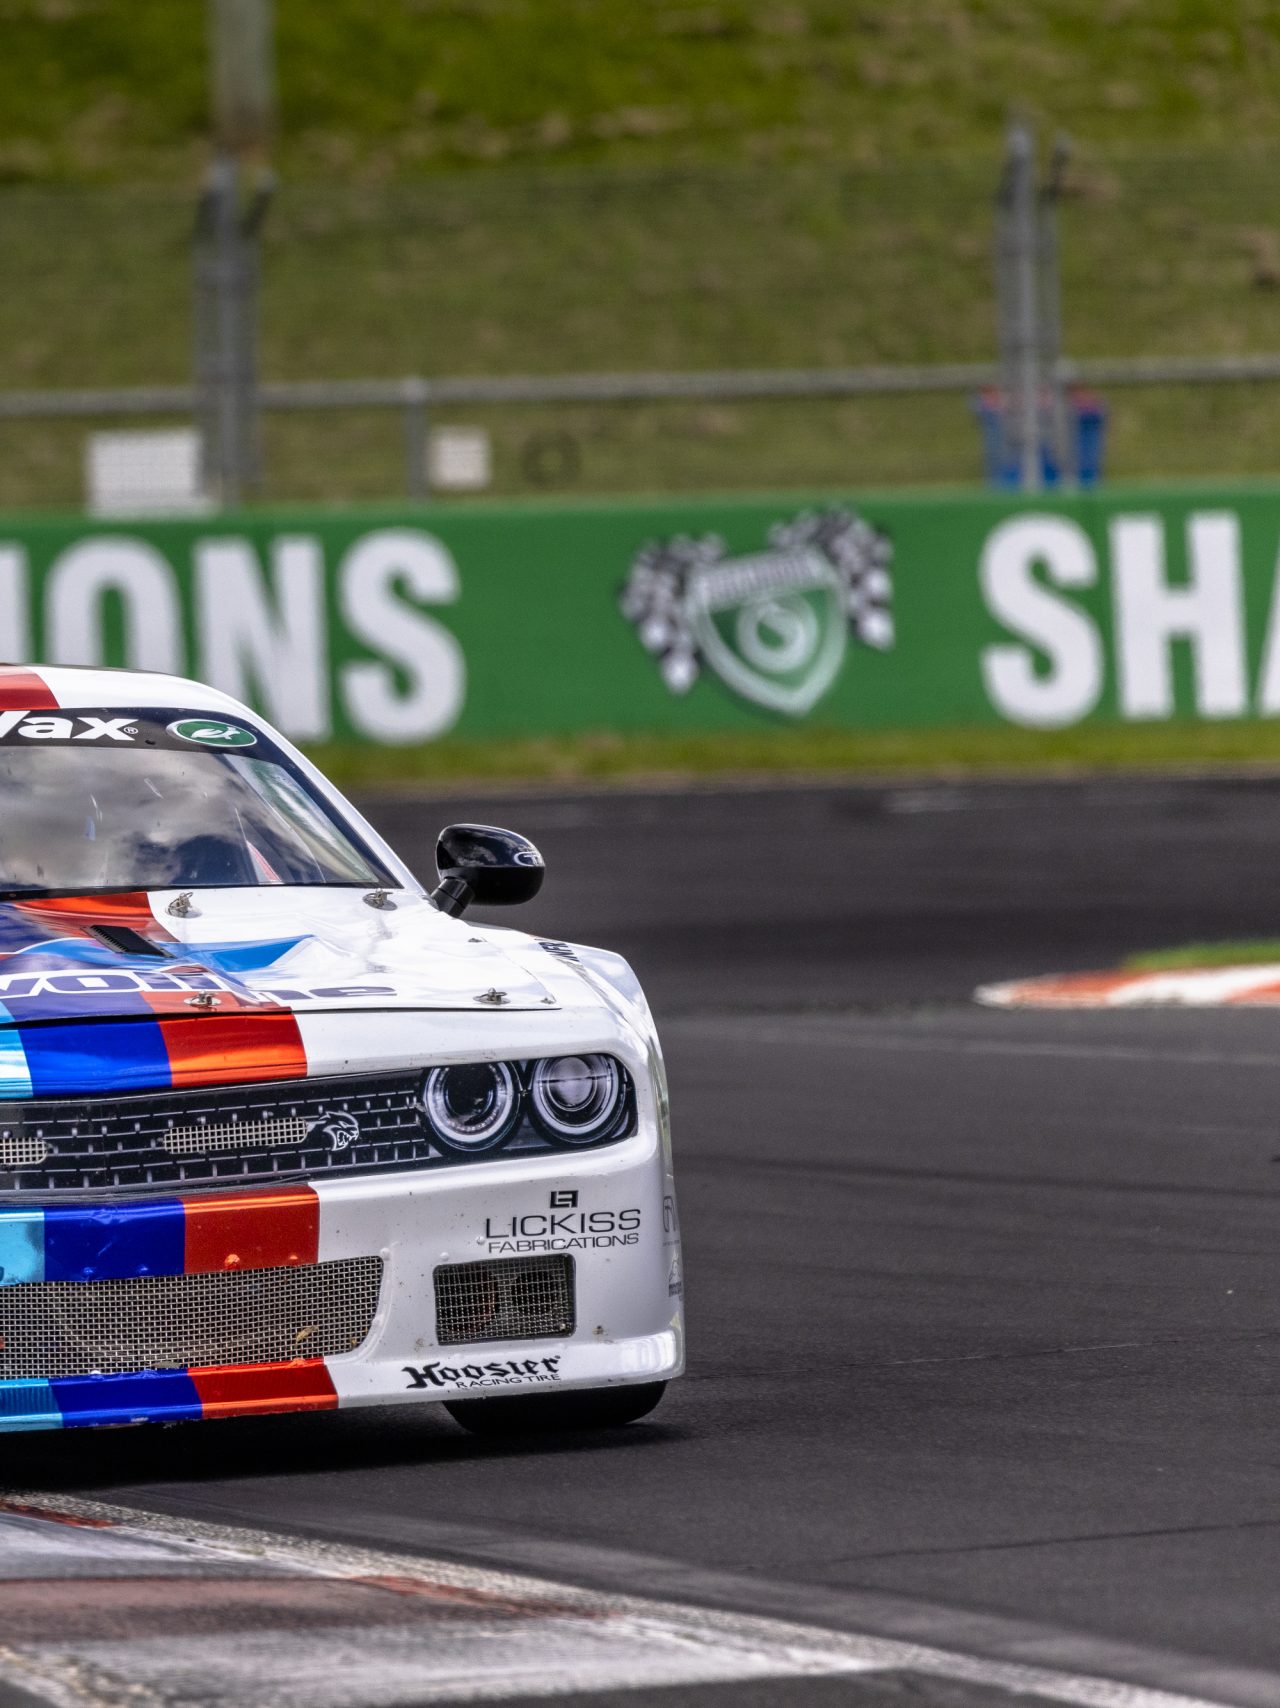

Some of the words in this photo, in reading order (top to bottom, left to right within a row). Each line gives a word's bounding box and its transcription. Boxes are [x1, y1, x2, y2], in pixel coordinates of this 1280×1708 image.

[980, 511, 1280, 730] SH
[485, 1208, 642, 1239] LICKISS
[487, 1232, 639, 1254] FABRICATIONS
[401, 1355, 561, 1389] Hoosier
[455, 1377, 521, 1389] RACING
[525, 1373, 561, 1382] TIRE
